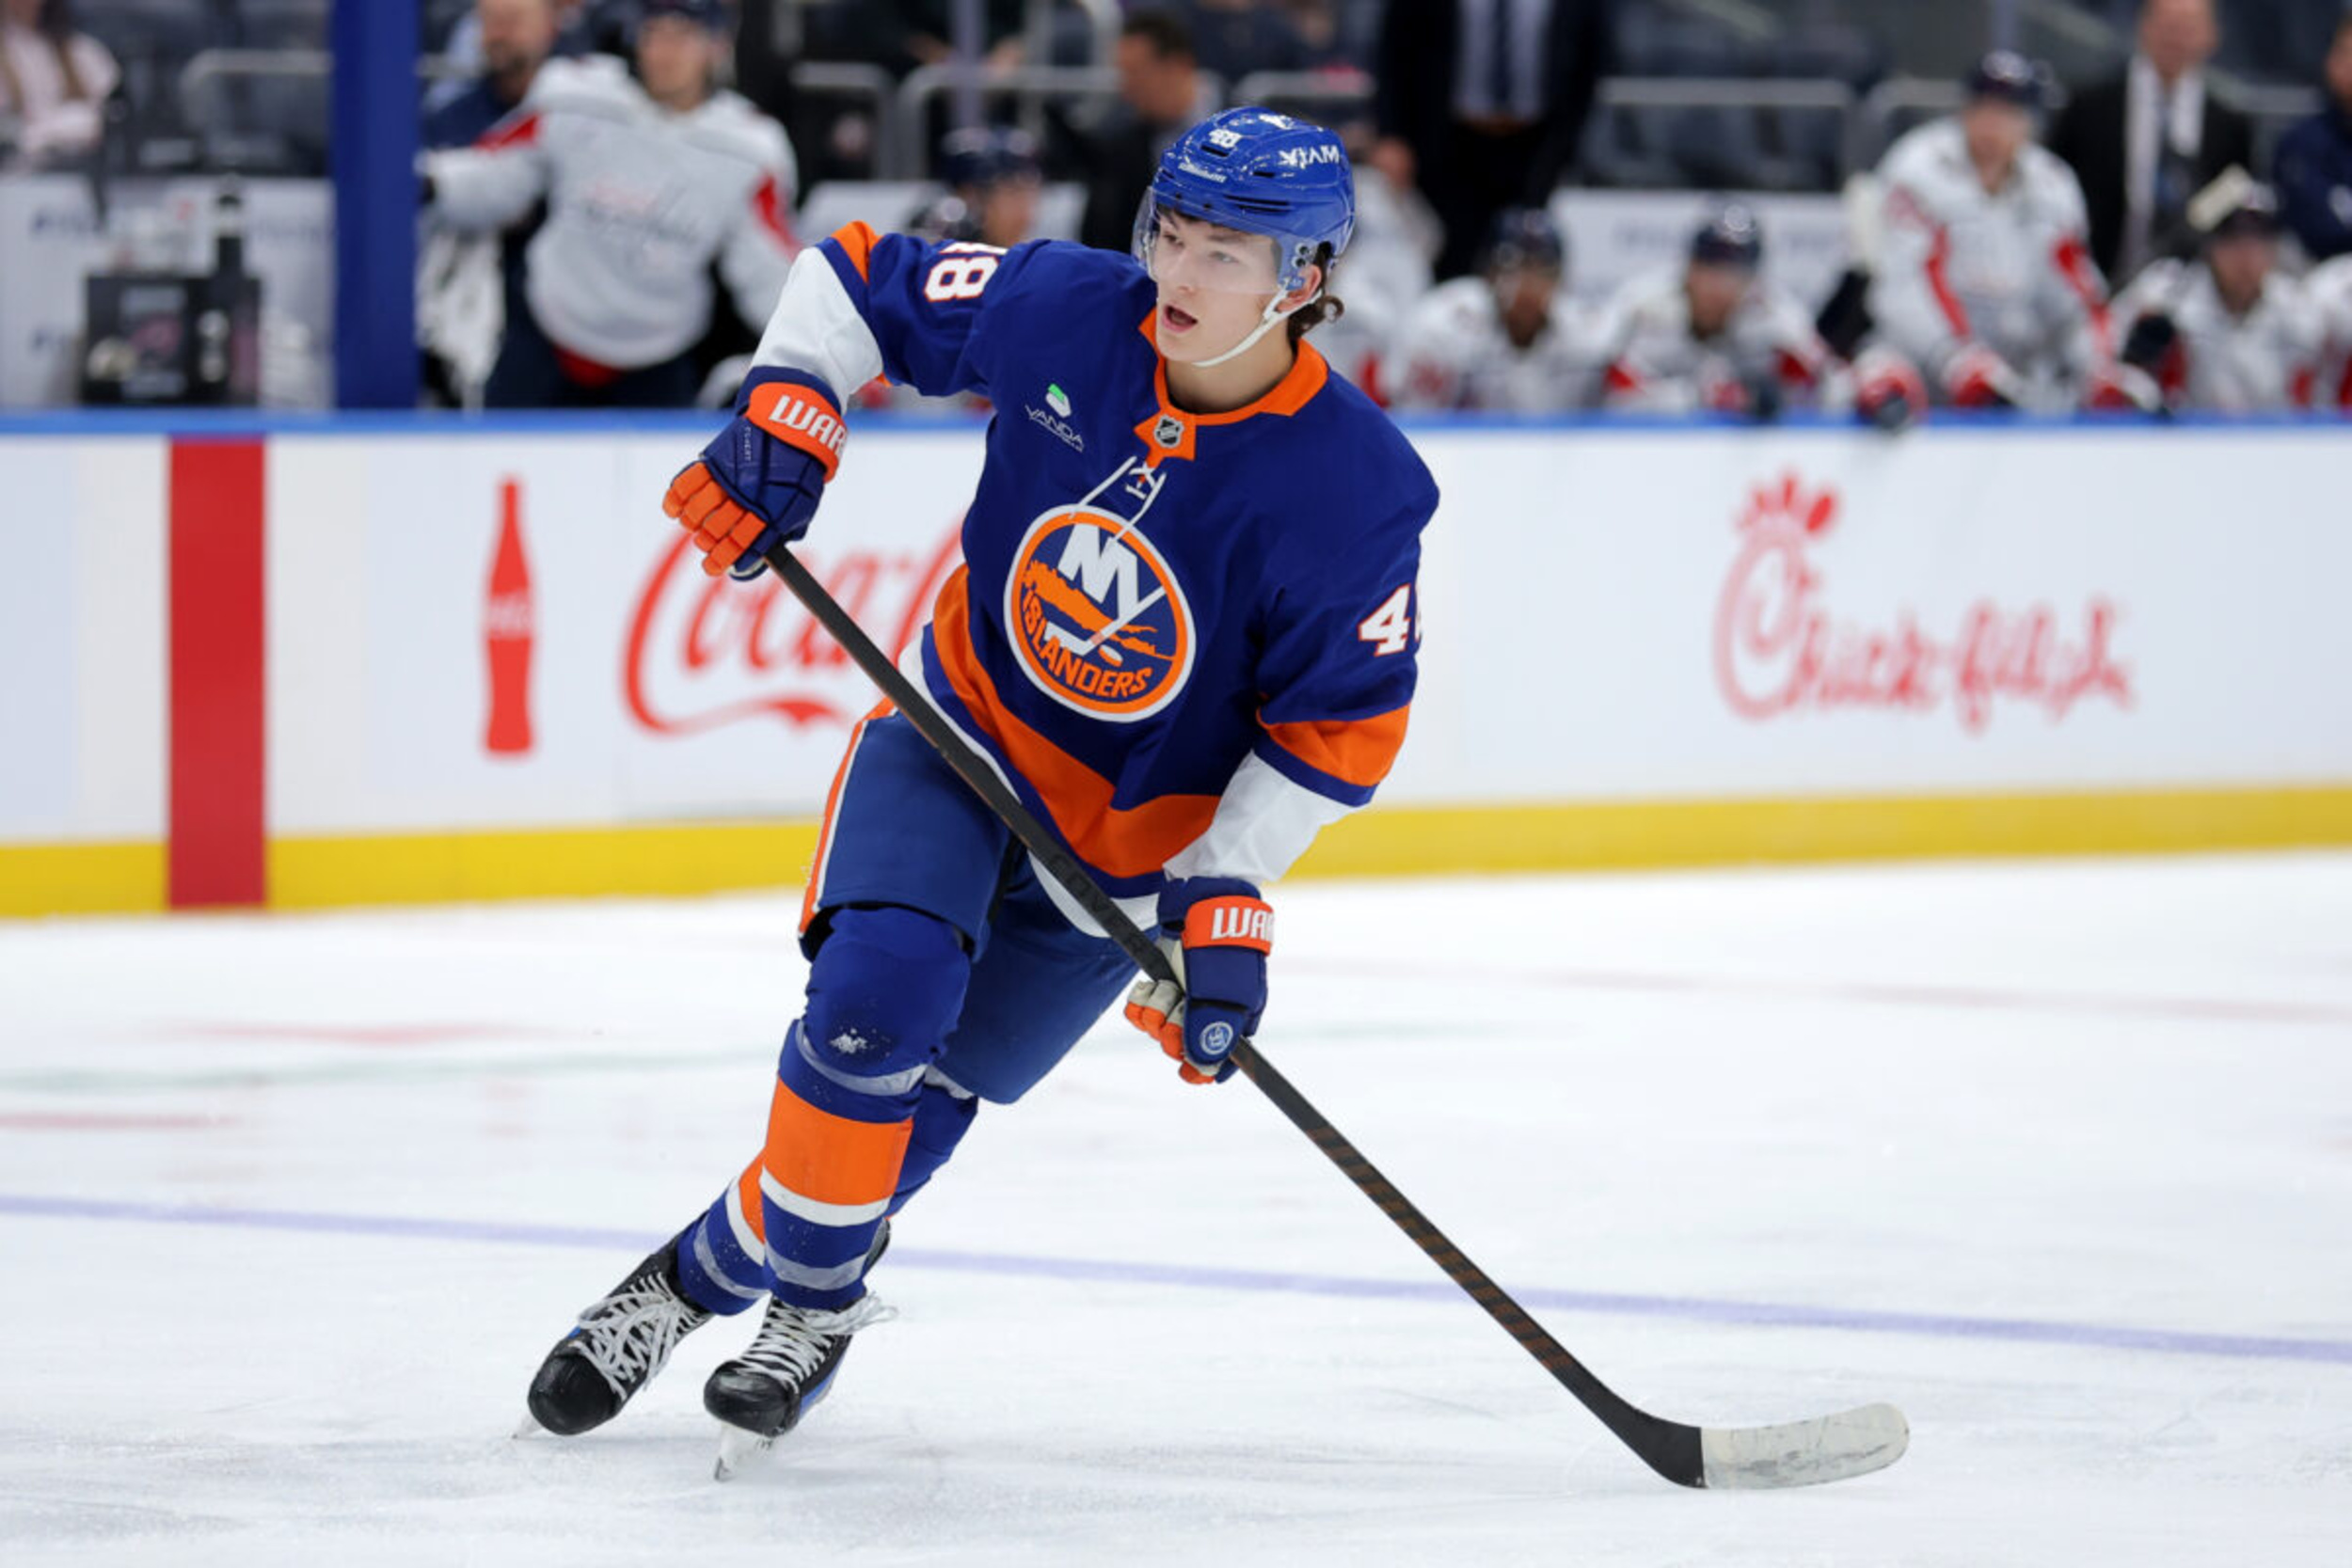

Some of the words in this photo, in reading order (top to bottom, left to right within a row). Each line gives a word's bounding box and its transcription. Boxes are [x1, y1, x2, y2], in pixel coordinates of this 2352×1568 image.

[923, 242, 1009, 302] 8
[1024, 404, 1085, 446] VANDA
[1057, 523, 1140, 621] NY
[1022, 589, 1153, 699] ISLANDERS
[1356, 582, 1422, 657] 4
